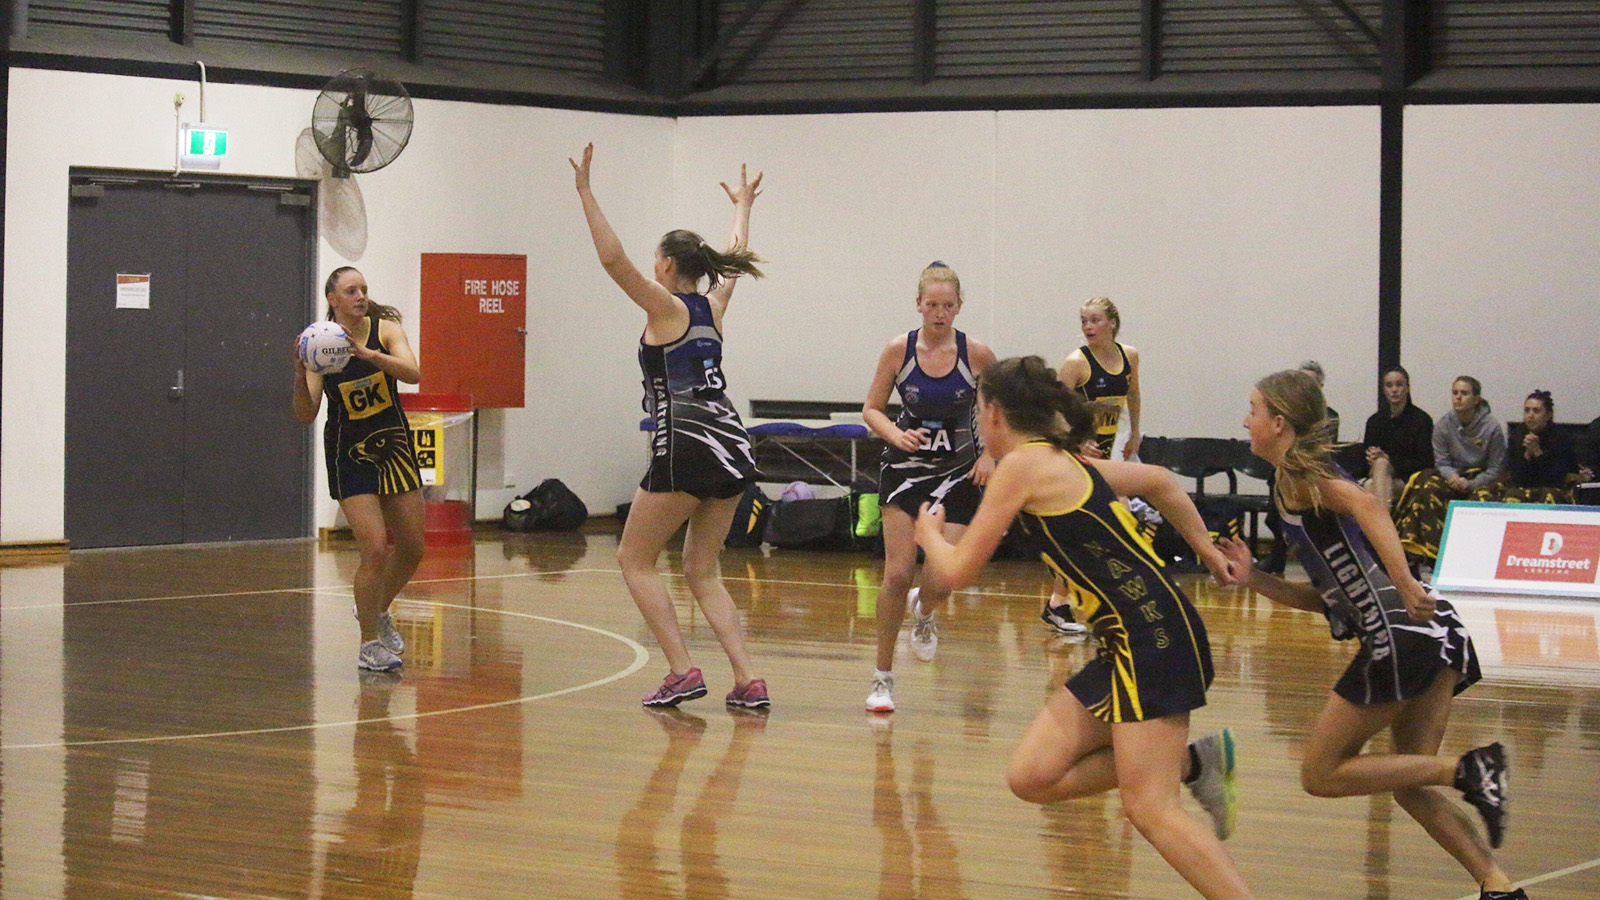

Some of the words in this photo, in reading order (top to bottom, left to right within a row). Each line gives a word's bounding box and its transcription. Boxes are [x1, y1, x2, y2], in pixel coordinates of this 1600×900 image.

[464, 279, 487, 295] FIRE
[491, 280, 520, 296] HOSE
[479, 298, 505, 313] REEL
[322, 346, 349, 355] GILBE
[348, 383, 385, 412] GK
[1505, 555, 1591, 570] Dreamstreet
